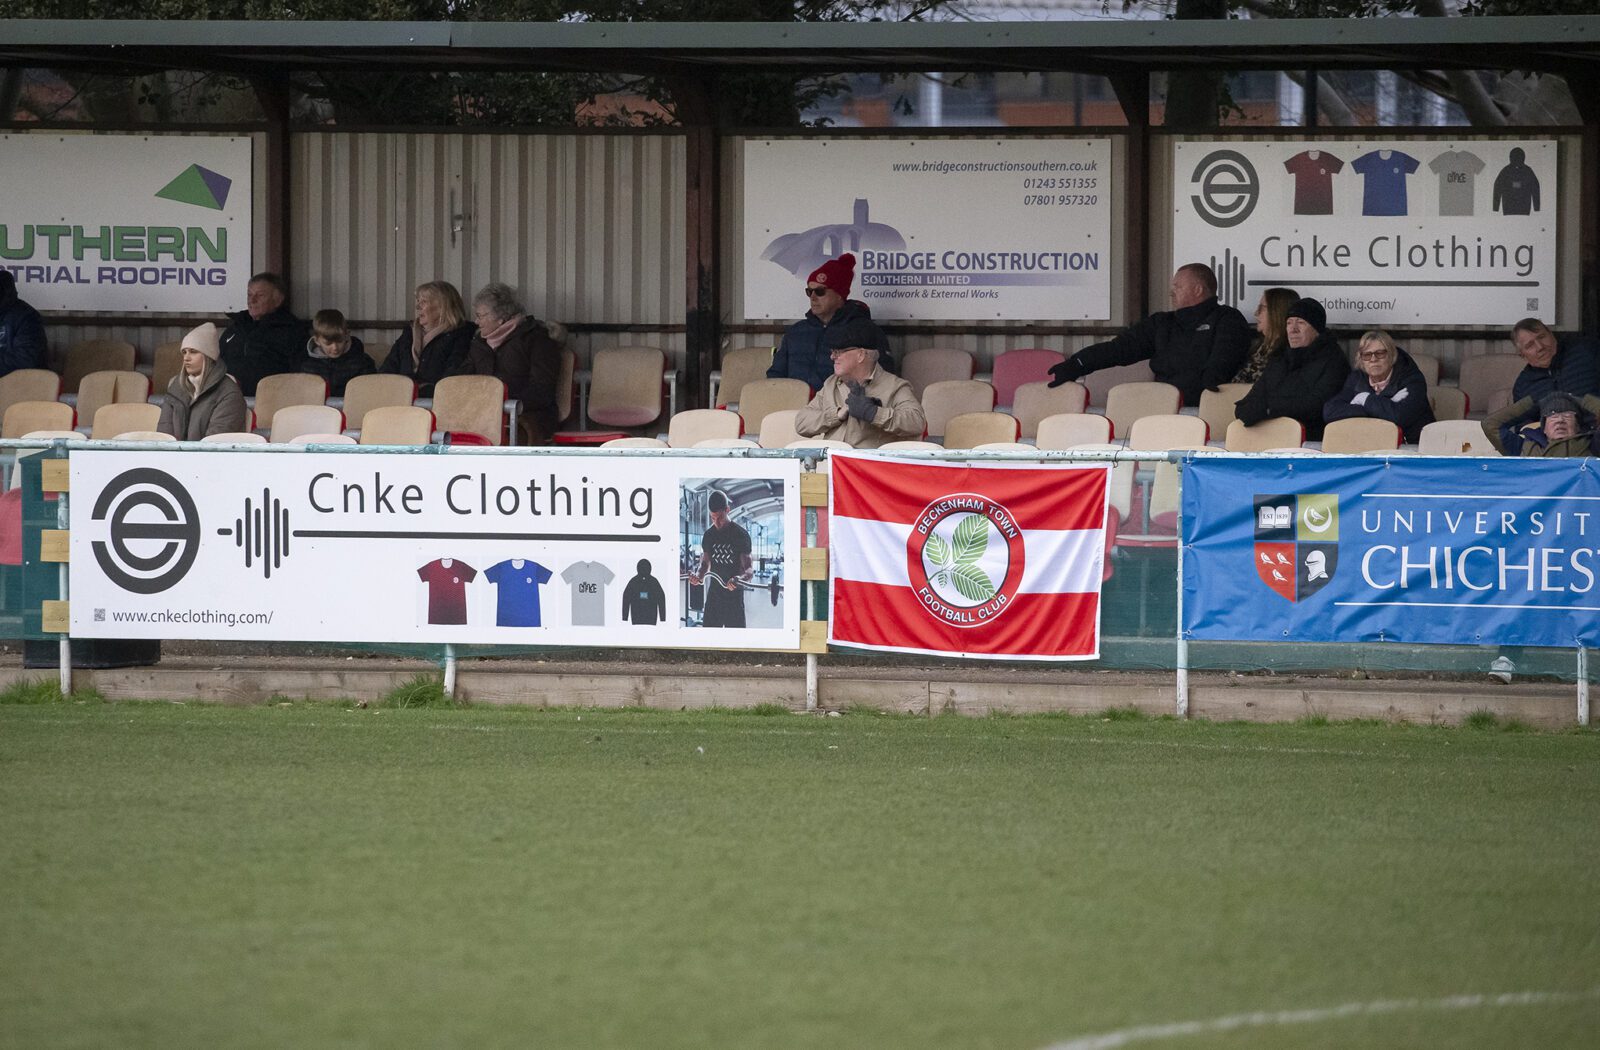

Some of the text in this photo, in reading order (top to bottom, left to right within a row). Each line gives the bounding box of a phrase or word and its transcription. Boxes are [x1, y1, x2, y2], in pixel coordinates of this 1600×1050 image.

[892, 161, 1098, 174] www.bridgeconstructionsouthern.co.uk
[1023, 178, 1097, 189] 01243 551355
[1023, 195, 1098, 206] 07801 957320
[0, 224, 228, 263] UTHERN
[862, 250, 1099, 270] BRIDGE CONSTRUCTION
[1260, 235, 1535, 277] Cnke Clothing
[0, 265, 227, 286] TRIAL ROOFING
[863, 275, 971, 285] SOUTHERN LIMITED
[863, 289, 999, 299] Groundwork & External Works
[308, 471, 653, 529] Cnke Clothing
[918, 498, 1018, 539] BECKENHAM TOWN
[1362, 510, 1591, 535] UNIVERSIT
[1361, 545, 1600, 593] CHICHES
[918, 587, 1008, 623] FOOTBALL CLUB
[112, 609, 274, 627] www.cnkeclothing.com/
